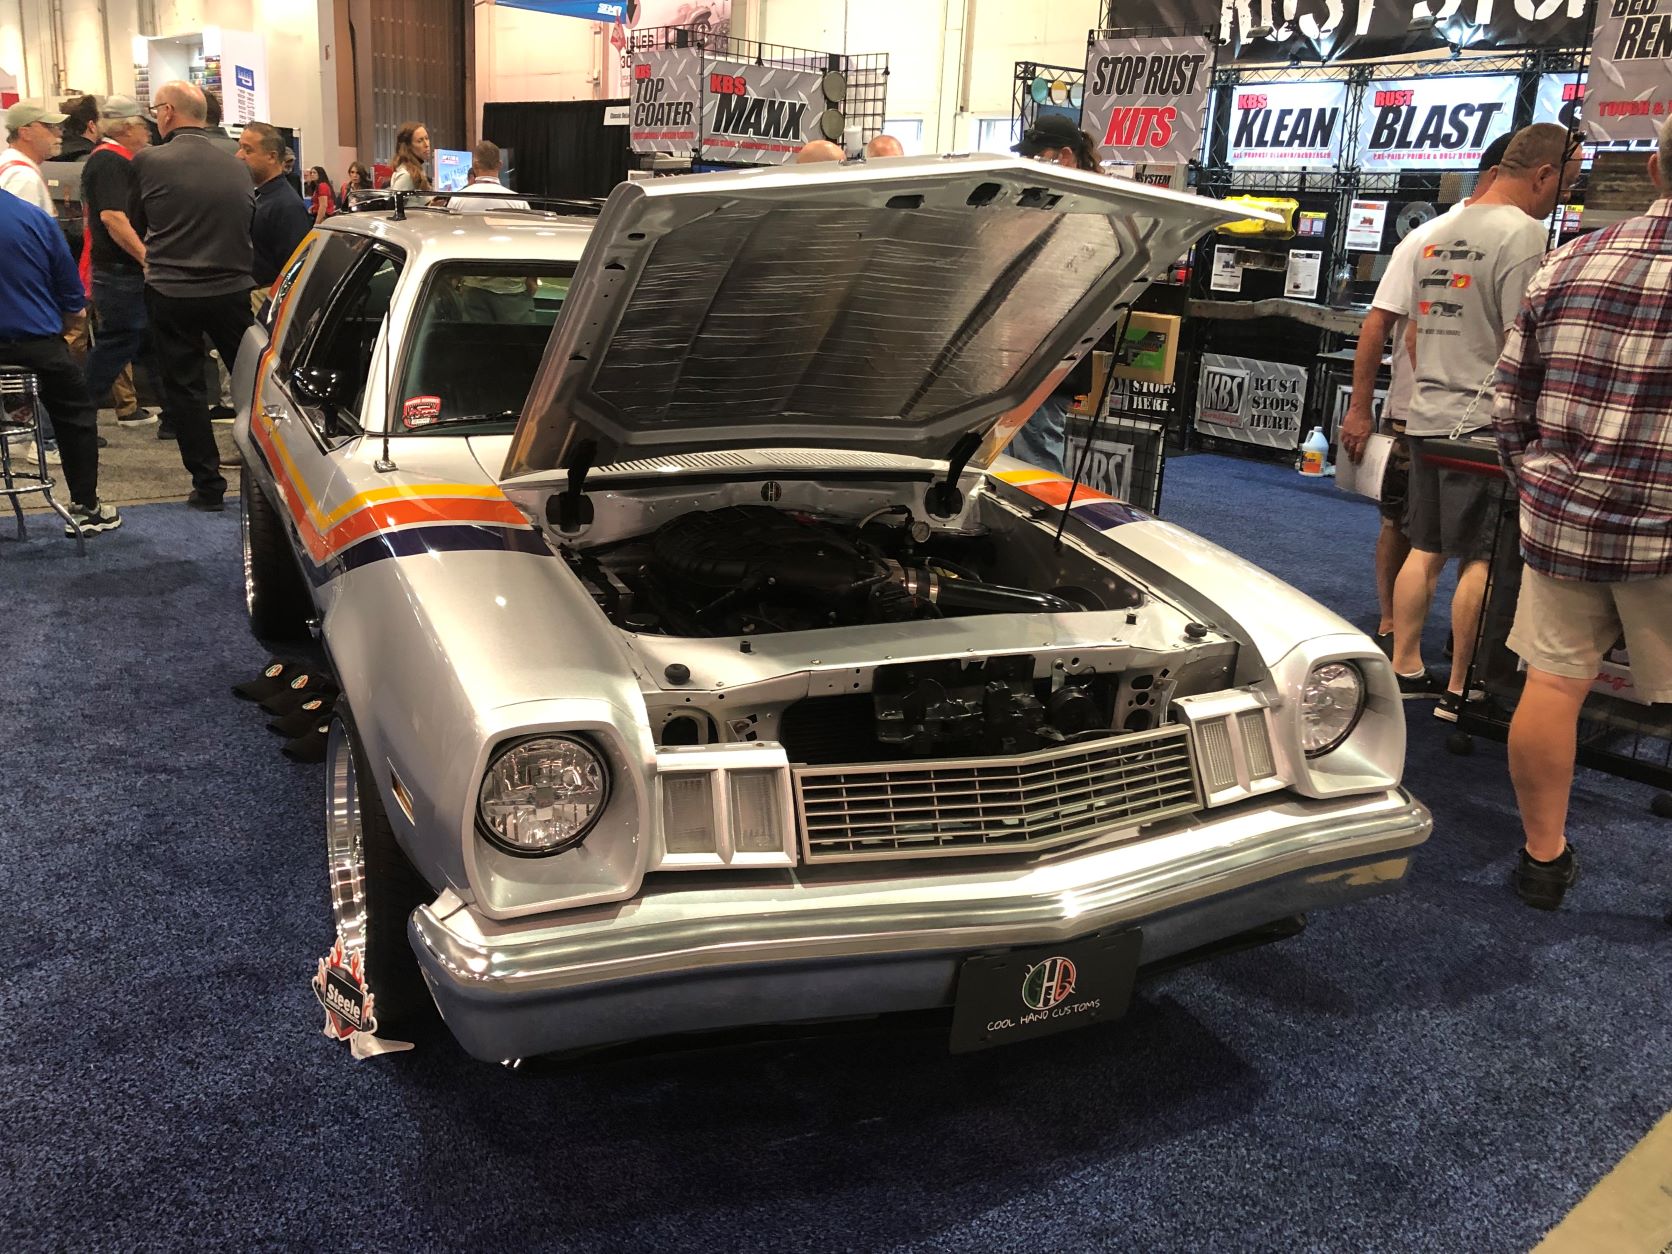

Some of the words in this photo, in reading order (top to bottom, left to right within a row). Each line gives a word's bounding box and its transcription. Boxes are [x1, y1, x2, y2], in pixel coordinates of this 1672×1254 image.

[710, 74, 746, 96] KBS
[1093, 55, 1147, 96] STOP
[1144, 54, 1205, 96] RUST
[636, 78, 665, 104] TOP
[1238, 94, 1267, 110] KBS
[1374, 90, 1414, 108] RUST
[634, 101, 694, 128] COATER
[711, 93, 807, 141] MAXX
[1104, 106, 1177, 148] KITS
[1233, 107, 1339, 148] KLEAN
[1368, 102, 1504, 150] BLAST
[1204, 373, 1242, 412] KBS
[1254, 377, 1300, 394] RUST
[1251, 395, 1299, 413] STOPS
[1249, 414, 1298, 431] HERE.
[326, 983, 361, 1019] Steele
[987, 1018, 1015, 1031] COOL
[1020, 1010, 1049, 1025] HAND
[1052, 999, 1101, 1018] CUSTOMS
